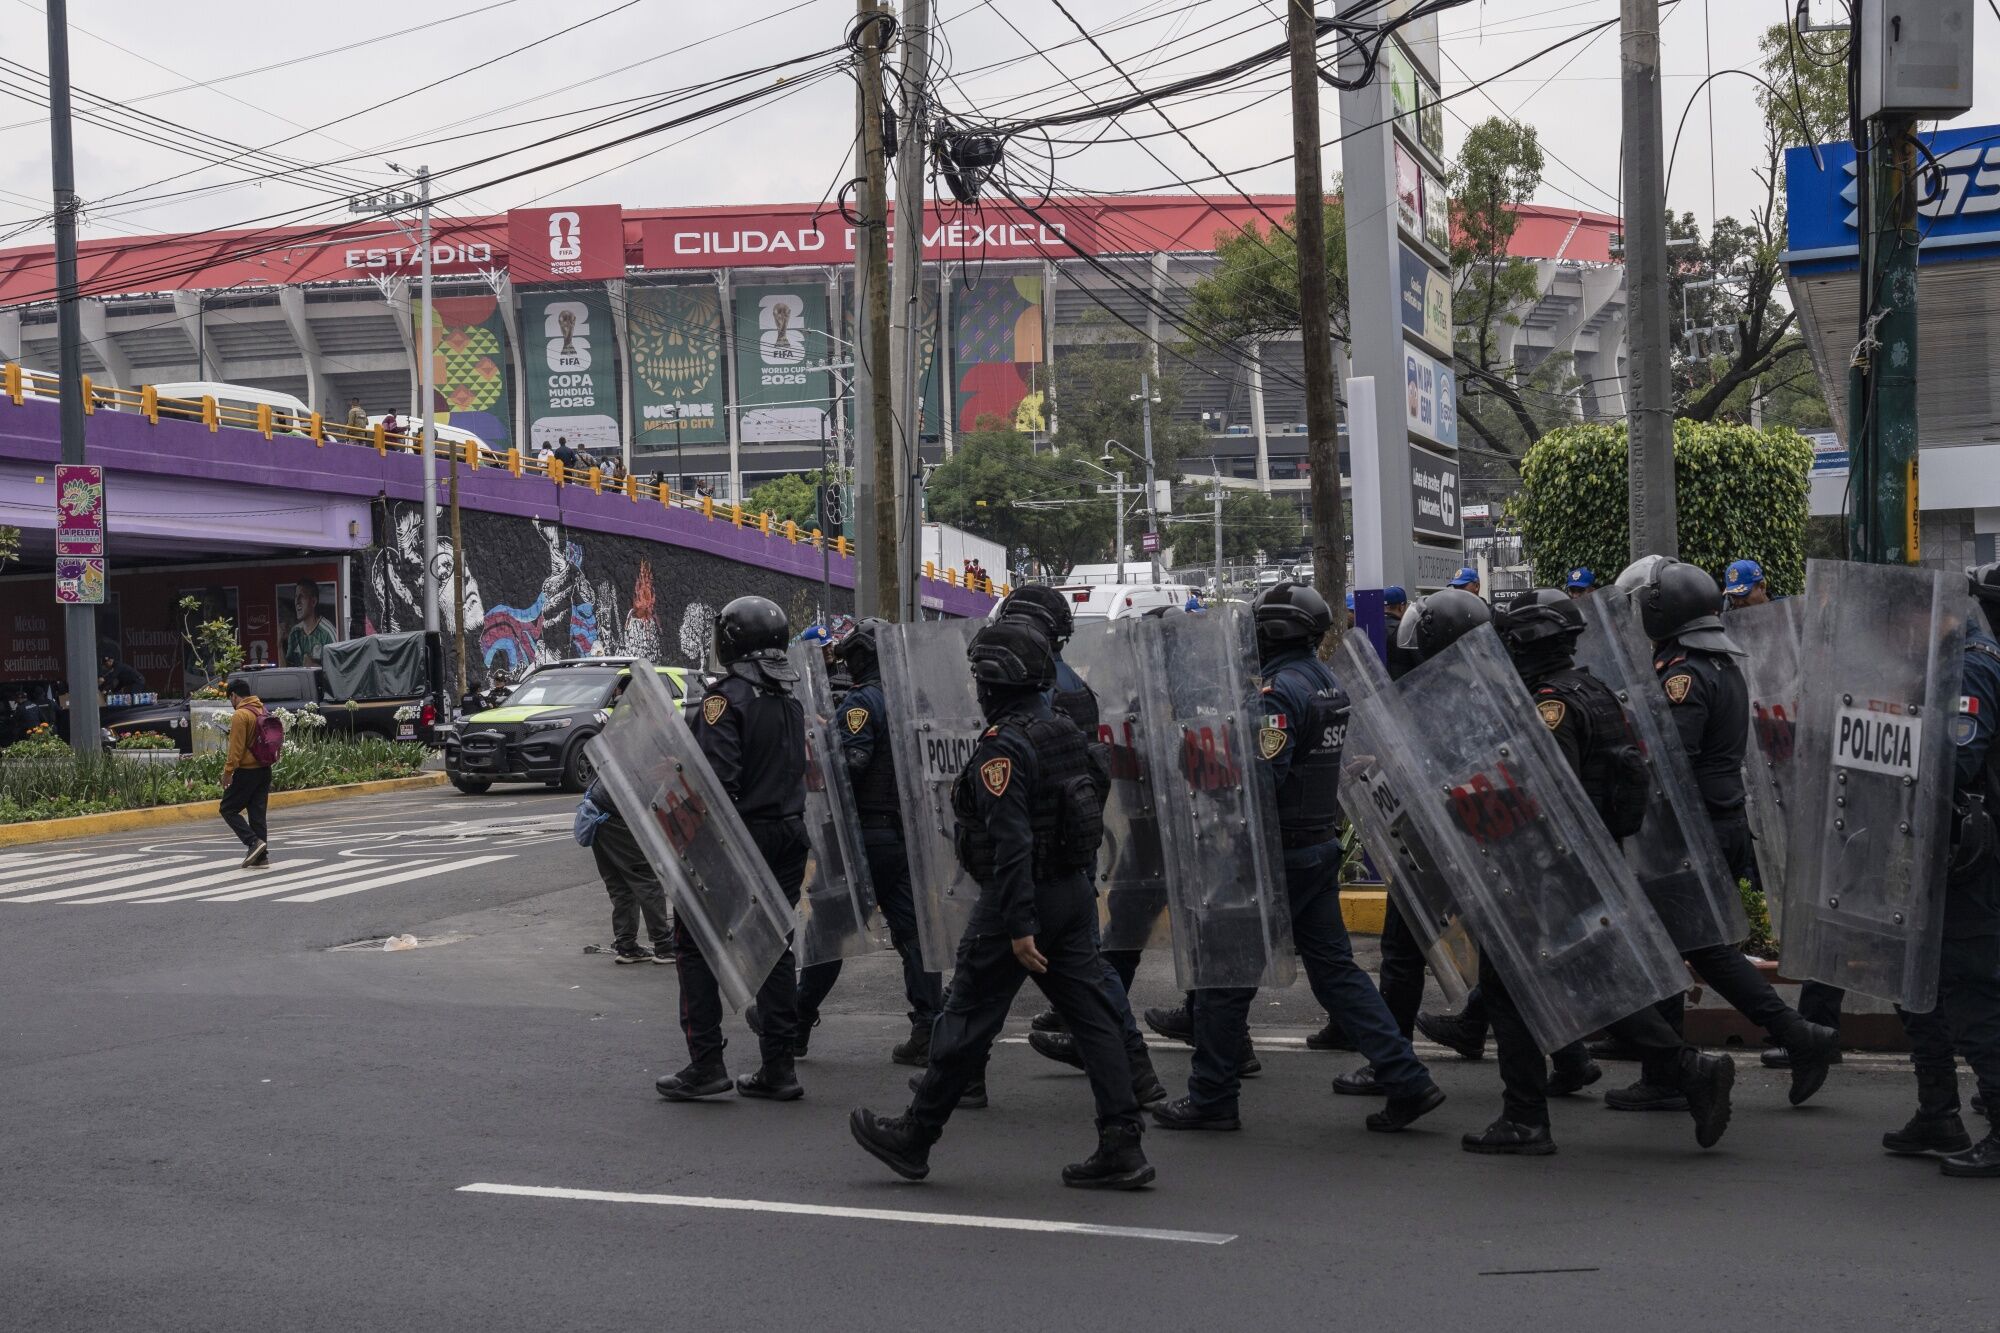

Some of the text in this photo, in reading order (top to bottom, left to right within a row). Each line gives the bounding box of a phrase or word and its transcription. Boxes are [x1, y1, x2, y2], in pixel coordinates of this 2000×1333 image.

[674, 229, 825, 254] CIUDAD
[922, 220, 1066, 246] MÉXICO
[346, 243, 491, 268] ESTADIO
[551, 266, 583, 275] 2026
[773, 348, 794, 359] FIFA
[560, 357, 580, 366] FIFA
[761, 366, 806, 375] WORLD CUP
[549, 374, 593, 388] COPA
[761, 375, 807, 386] 2026
[549, 388, 594, 397] MUNDIAL
[550, 397, 595, 408] 2026
[691, 418, 715, 429] CITY
[59, 528, 100, 537] LA PELOTA
[15, 615, 46, 633] México
[126, 627, 178, 647] Sintamos
[4, 656, 60, 673] sentimiento,
[1838, 715, 1913, 769] POLICIA
[984, 761, 1007, 774] POLICIA
